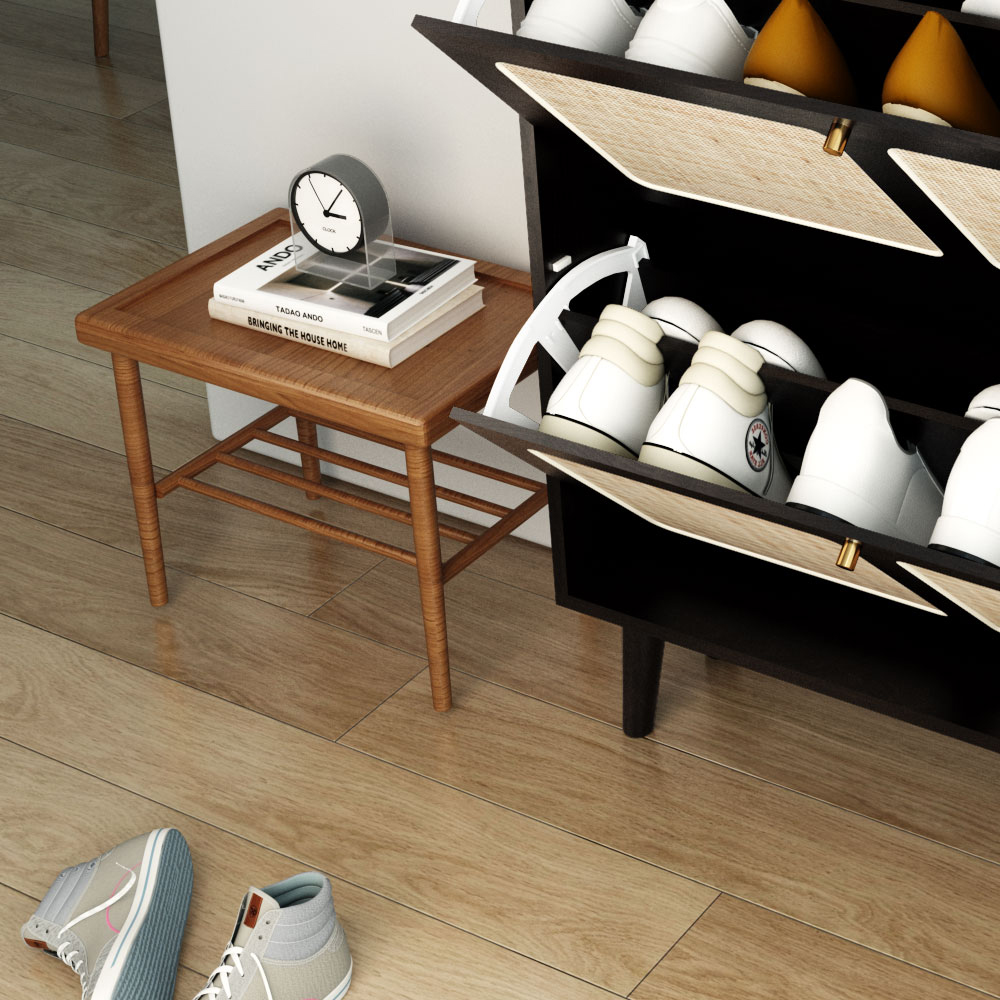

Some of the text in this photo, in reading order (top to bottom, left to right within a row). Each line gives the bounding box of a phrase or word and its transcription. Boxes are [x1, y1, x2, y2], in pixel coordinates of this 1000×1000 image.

[256, 244, 303, 271] ANDO
[276, 305, 324, 323] TADAO ANDO
[247, 316, 348, 352] BRINGING THE HOUSE HOME
